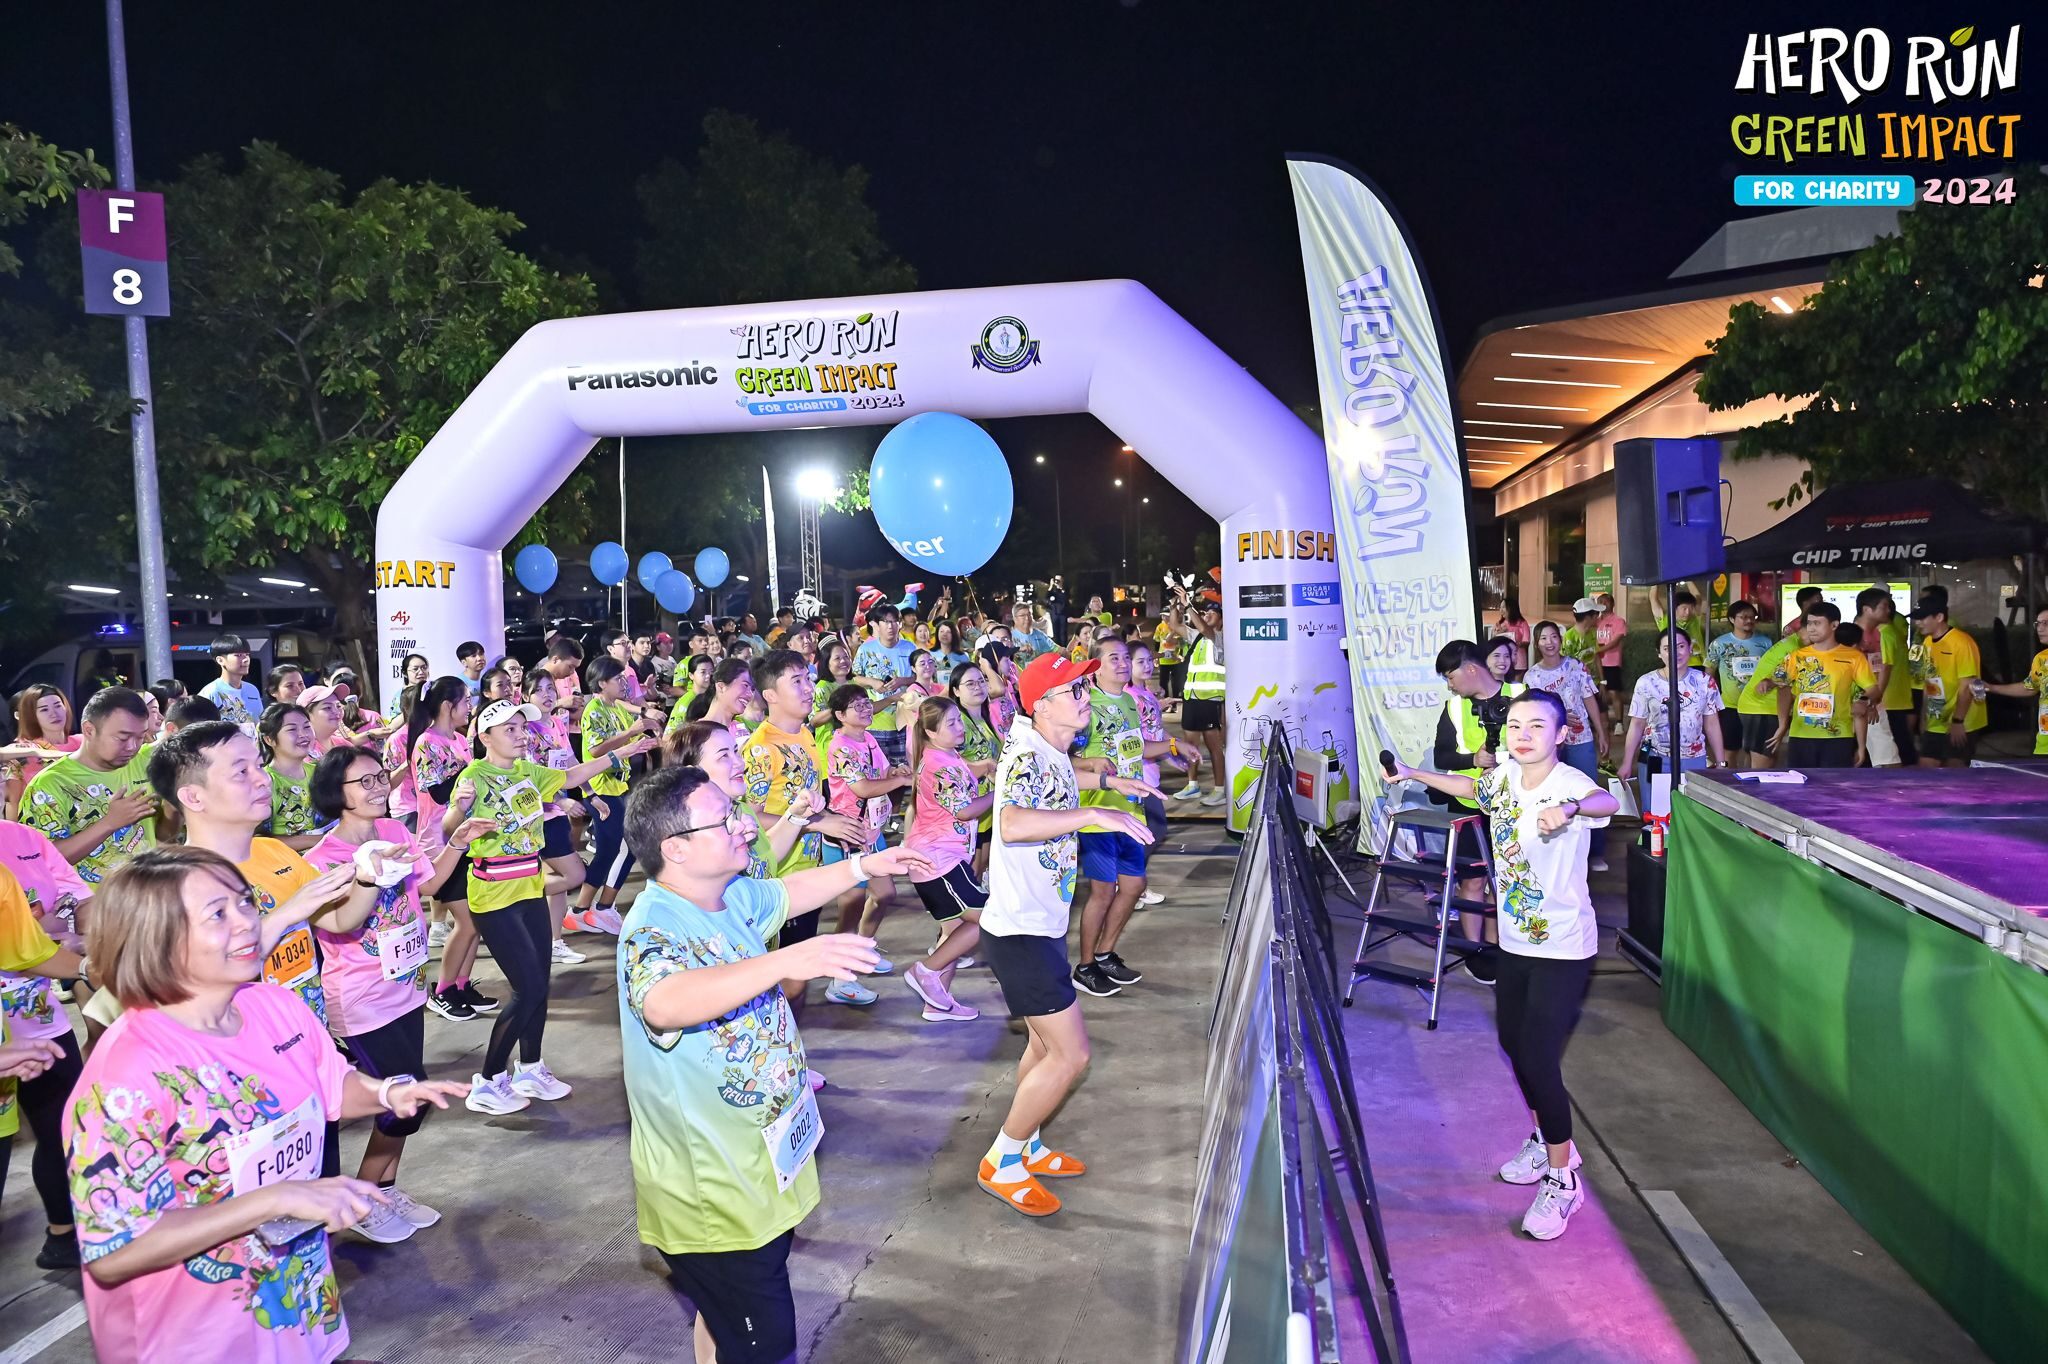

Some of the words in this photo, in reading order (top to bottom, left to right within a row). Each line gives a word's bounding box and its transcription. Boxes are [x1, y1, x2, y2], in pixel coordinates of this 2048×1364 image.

[108, 197, 135, 234] F
[112, 268, 144, 305] 8
[737, 317, 825, 362] HERO
[831, 310, 900, 359] RUN
[567, 360, 718, 391] Panasonic
[735, 365, 813, 397] GREEN
[815, 362, 898, 393] IMPACT
[757, 403, 782, 414] FOR
[786, 399, 839, 413] CHARITY
[850, 394, 905, 410] 2024
[1237, 530, 1335, 563] FINISH
[1792, 549, 1842, 566] CHIP
[1850, 543, 1928, 562] TIMING
[390, 637, 417, 649] amino
[271, 937, 311, 971] M-0347
[790, 1111, 812, 1151] 0002
[257, 1131, 312, 1186] F-0280
